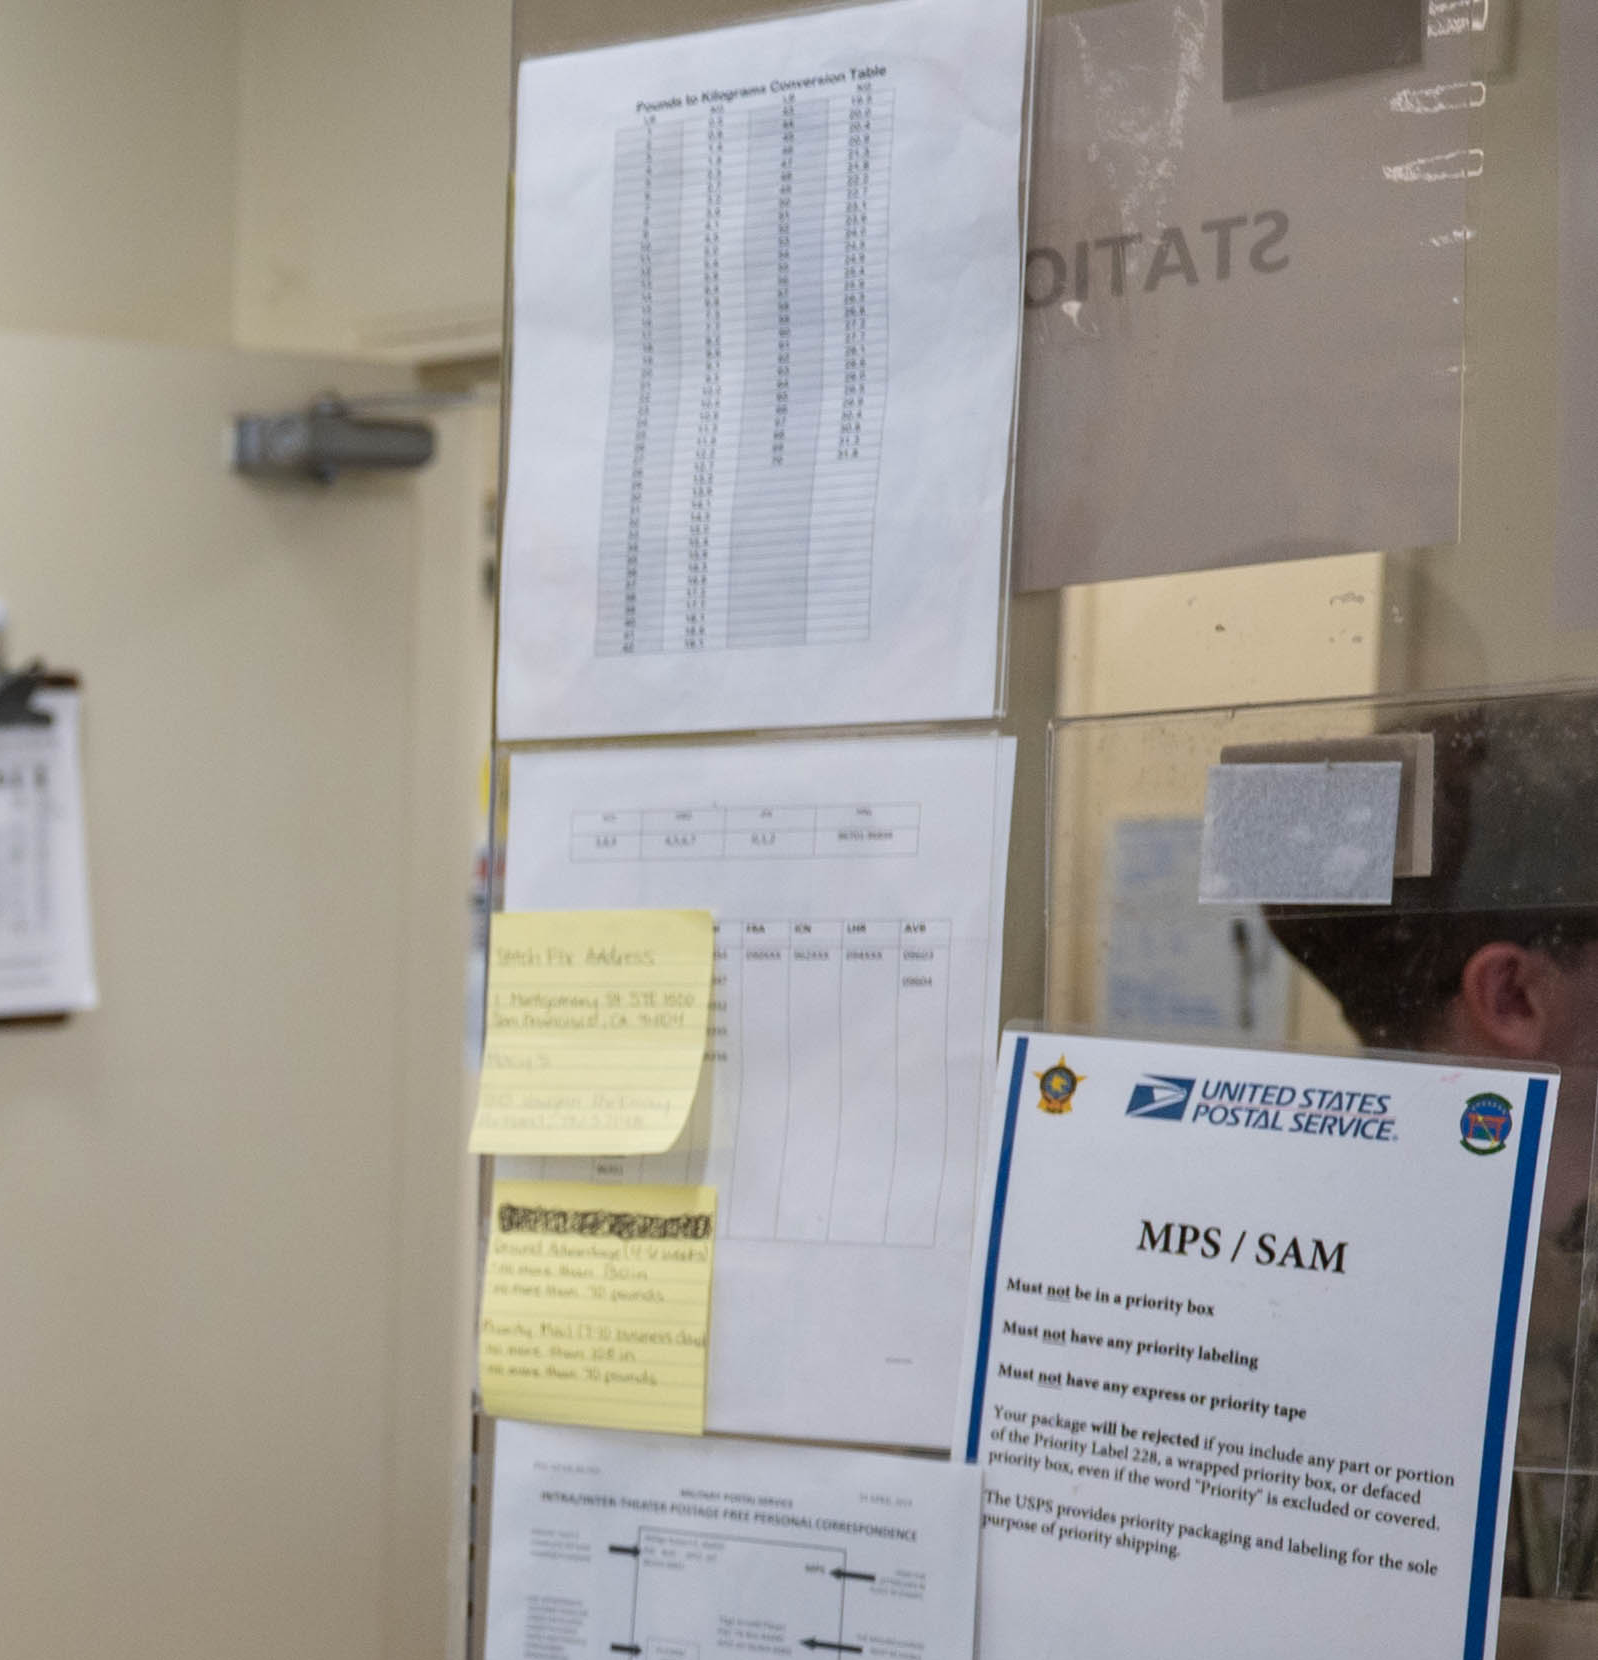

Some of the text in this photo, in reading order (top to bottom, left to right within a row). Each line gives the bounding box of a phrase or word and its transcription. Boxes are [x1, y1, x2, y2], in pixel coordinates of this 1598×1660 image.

[636, 64, 887, 114] Pounds to Kilograms Conversion Table
[1192, 1103, 1284, 1132] POSTAL
[1201, 1079, 1392, 1115] UNITED STATES
[1137, 1219, 1349, 1274] MPS / SAM
[1007, 1277, 1215, 1317] Must not be in a priority box
[1002, 1320, 1259, 1371] Must not have any priority labeling
[997, 1362, 1307, 1423] Must not have any express or priority tape
[990, 1427, 1422, 1505] of the Priority Label 228, a wrapped priority box, or defaced
[994, 1405, 1455, 1487] Your package will be rejected if you include any part or portion
[988, 1450, 1041, 1472] priority
[1044, 1455, 1074, 1475] box,
[1077, 1465, 1110, 1480] even
[1114, 1467, 1127, 1482] if
[1128, 1470, 1150, 1486] the
[1154, 1476, 1191, 1493] word
[1266, 1491, 1279, 1506] is
[1282, 1495, 1350, 1518] excluded
[1354, 1507, 1371, 1520] or
[1375, 1510, 1441, 1532] covered.
[671, 1503, 718, 1520] POSTAGE
[723, 1508, 750, 1522] FREE
[753, 1512, 812, 1530] PERSONAL
[815, 1520, 918, 1543] CORRESPONDENCE
[982, 1514, 1180, 1560] purpose of priority shipping.
[985, 1489, 1438, 1576] The USPS provides priority packaging and labeling for the sole
